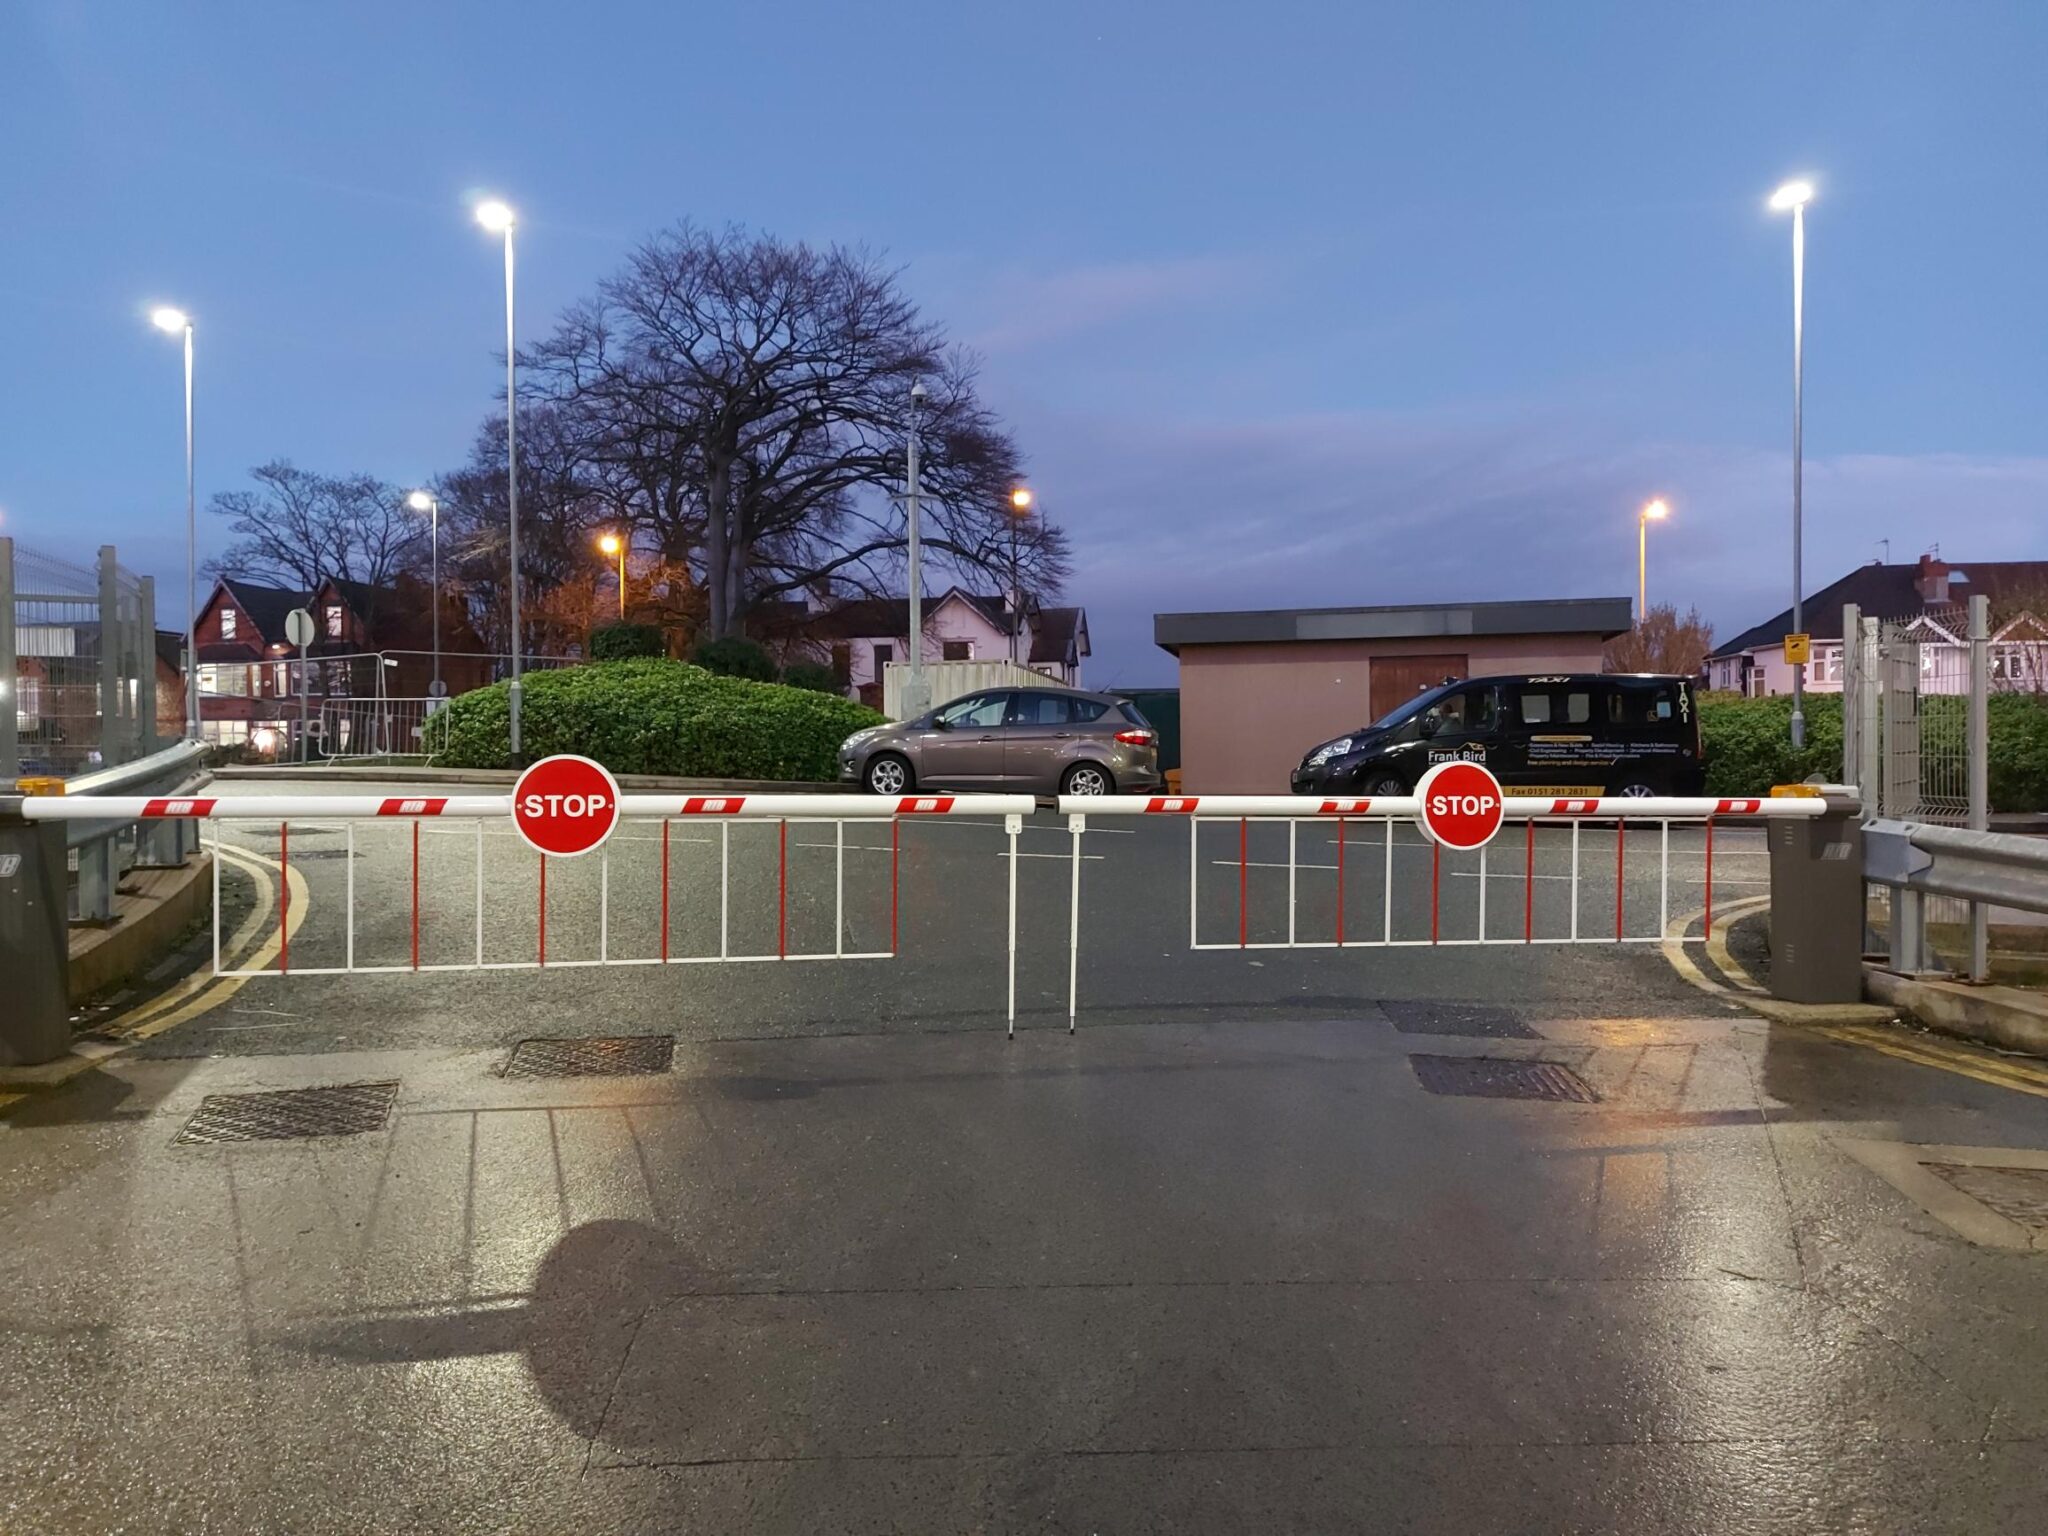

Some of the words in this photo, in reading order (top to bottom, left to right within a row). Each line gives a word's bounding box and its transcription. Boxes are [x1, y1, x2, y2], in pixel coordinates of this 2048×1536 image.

[1678, 682, 1689, 723] TAXI
[1428, 751, 1460, 761] Frank
[1463, 751, 1486, 761] Bird
[525, 794, 606, 817] STOP
[1432, 795, 1494, 815] STOP
